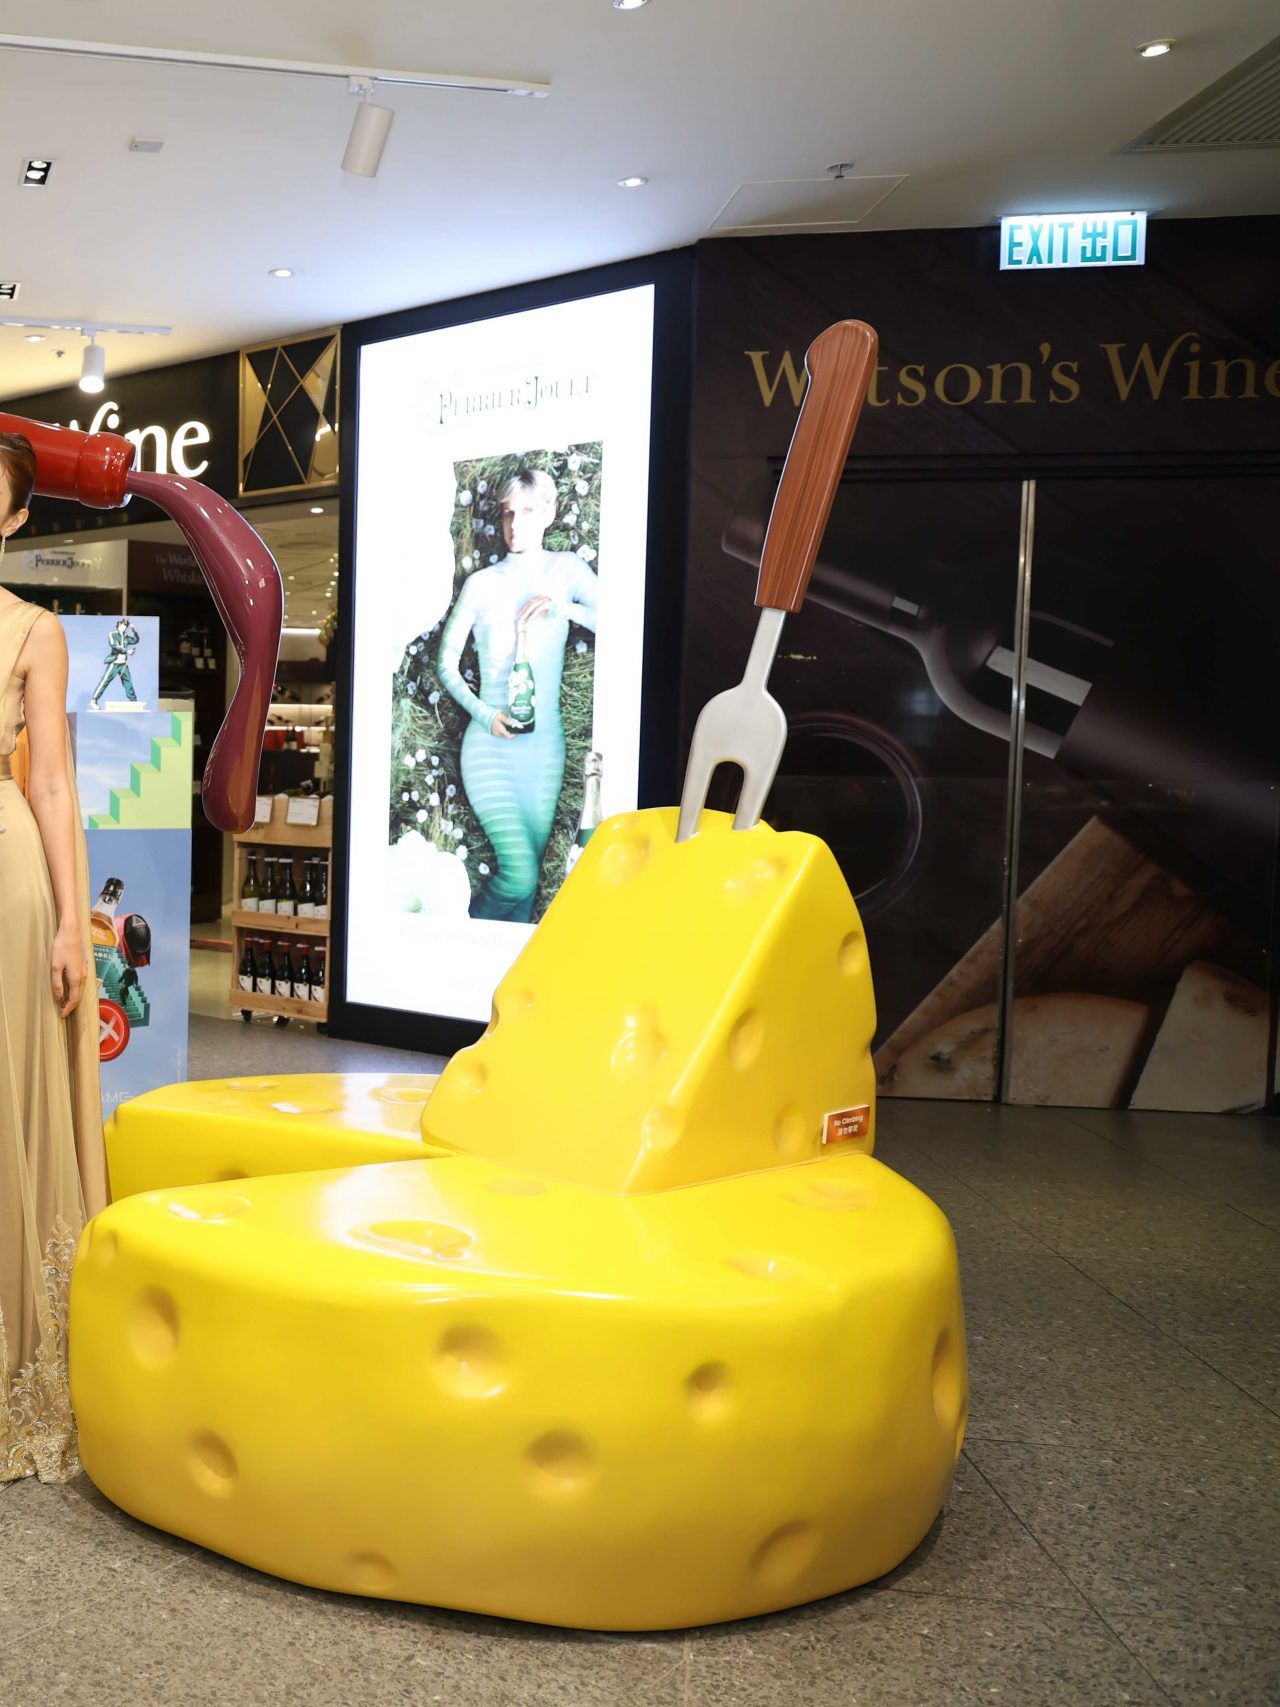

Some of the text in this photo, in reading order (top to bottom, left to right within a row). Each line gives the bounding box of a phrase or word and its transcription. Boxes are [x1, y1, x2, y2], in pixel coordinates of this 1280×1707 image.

[1007, 222, 1075, 266] EXIT
[1080, 219, 1138, 263] 出口
[743, 340, 1081, 408] Wtson's
[833, 1114, 864, 1127] No Climbing
